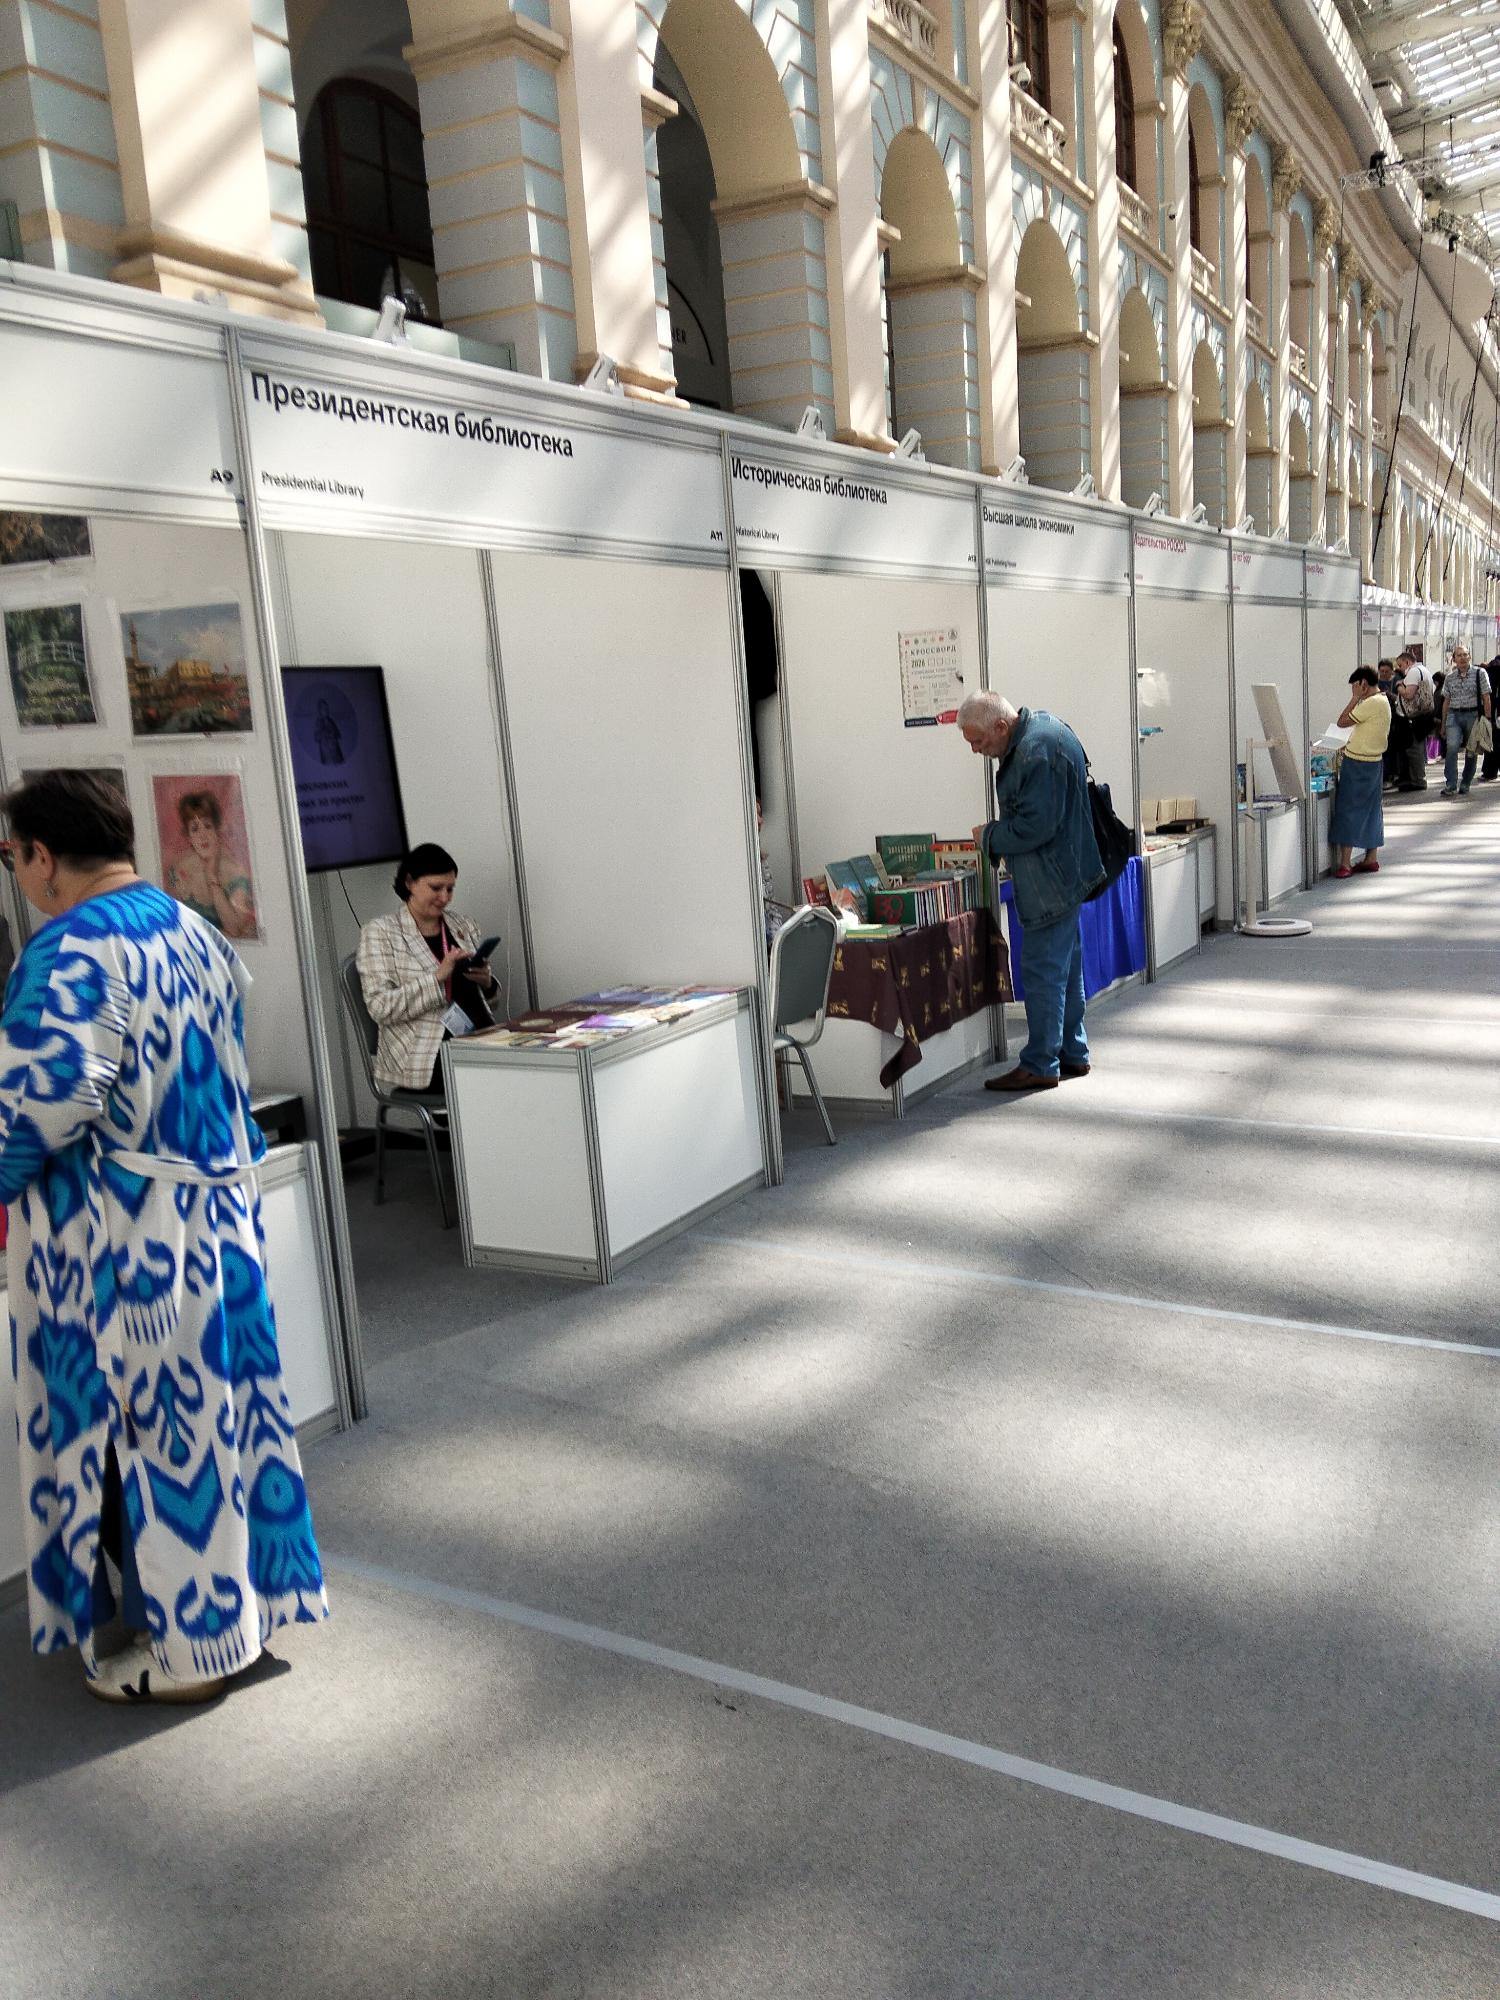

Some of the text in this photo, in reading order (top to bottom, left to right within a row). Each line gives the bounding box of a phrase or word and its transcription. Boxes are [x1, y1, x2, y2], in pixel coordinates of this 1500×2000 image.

[251, 371, 574, 457] Президентская библиотека
[211, 468, 235, 484] A9
[261, 470, 364, 501] Presidential Library
[731, 456, 888, 505] Историческая библиотека
[983, 505, 1075, 536] Высшая школа экономики
